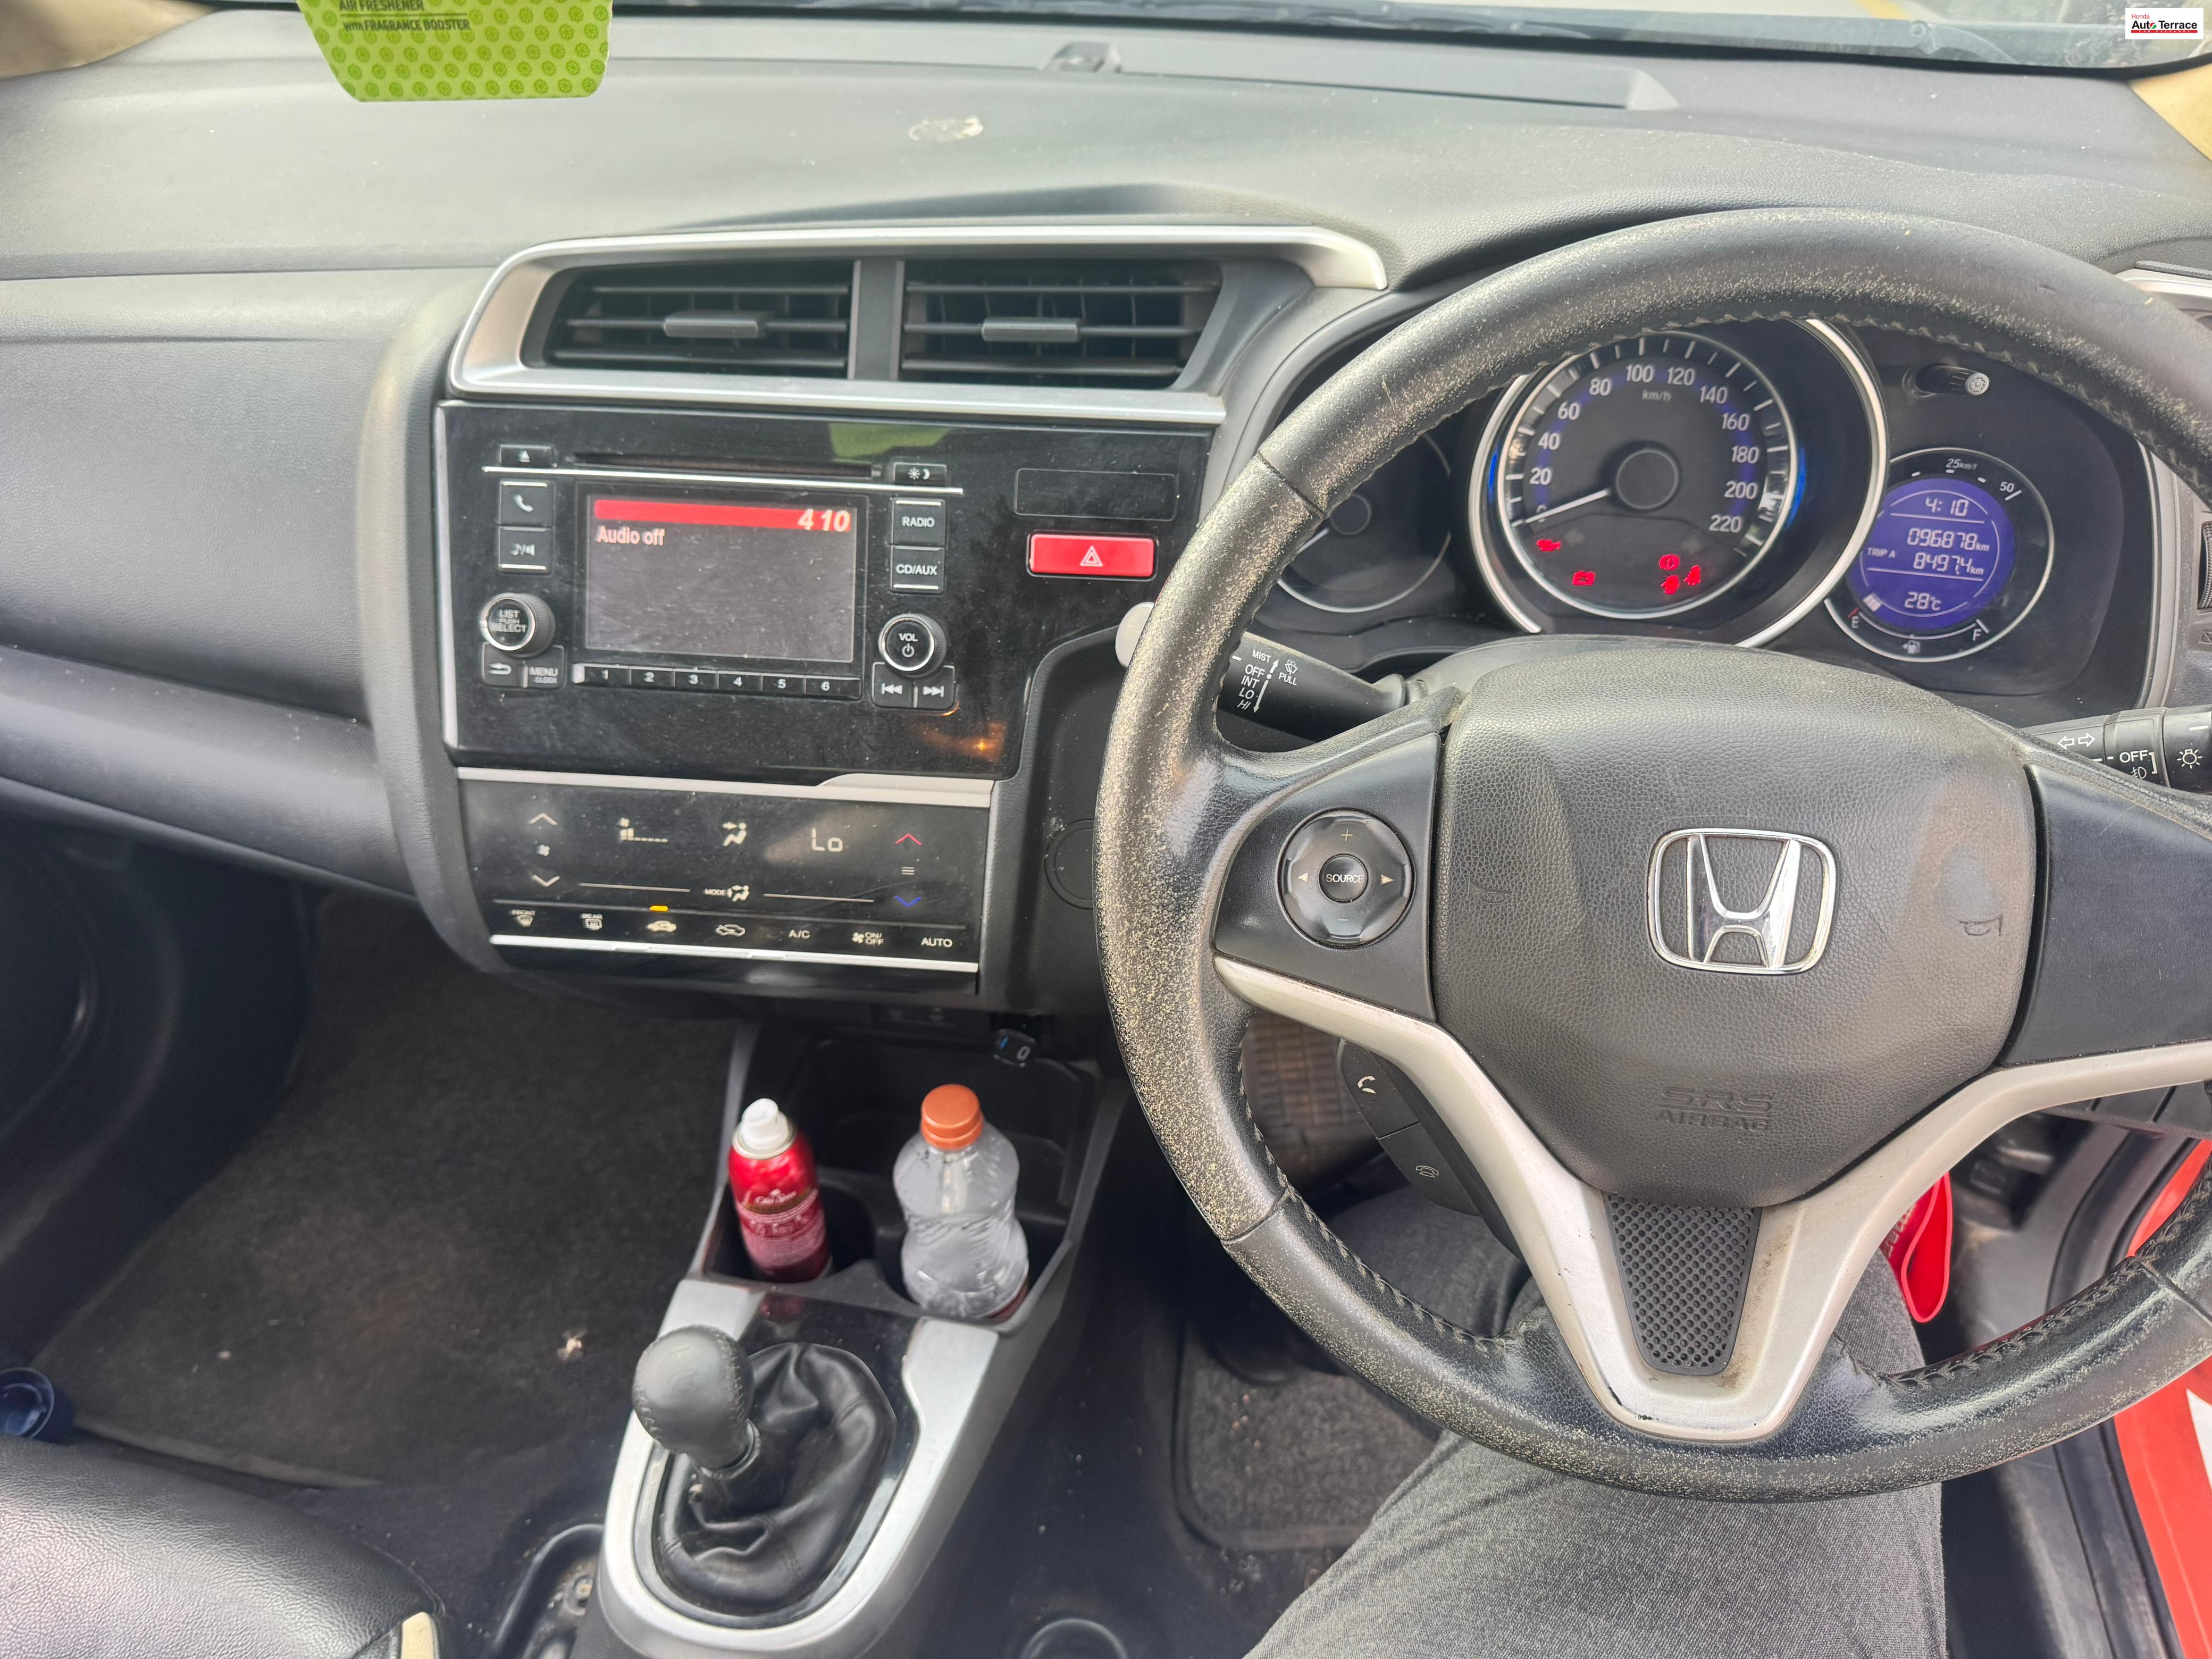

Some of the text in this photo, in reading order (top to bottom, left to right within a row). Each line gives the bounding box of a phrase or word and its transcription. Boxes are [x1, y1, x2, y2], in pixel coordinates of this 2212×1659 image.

[340, 0, 358, 11] AIR
[364, 20, 422, 31] FRAGRANCE
[424, 19, 470, 30] BOOSTER
[1625, 364, 1655, 383] 100
[1666, 365, 1695, 385] 120
[1589, 377, 1611, 397] 80
[1641, 389, 1671, 403] km/h
[1699, 385, 1729, 405] 140
[1557, 402, 1580, 422] 60
[1721, 411, 1750, 431] 160
[1538, 431, 1561, 450] 40
[1731, 444, 1759, 464] 180
[1529, 467, 1553, 486] 20
[1723, 480, 1757, 500] 200
[1999, 481, 2015, 492] 50
[901, 516, 935, 527] RADIO
[1708, 514, 1742, 533] 220
[596, 525, 665, 546] Audio off
[1866, 547, 1888, 558] TRIP
[1889, 550, 1896, 558] A
[895, 564, 937, 576] CD/AUX
[498, 609, 521, 619] LIST
[492, 623, 527, 633] SELECT
[1851, 615, 1859, 629] E
[898, 632, 919, 642] VOL
[1972, 629, 1982, 641] F
[1252, 649, 1271, 663] MIST
[529, 666, 558, 677] MENU
[601, 669, 609, 680] 1
[643, 671, 655, 683] 2
[1245, 664, 1265, 678] OFF
[688, 674, 699, 685] 3
[733, 676, 742, 687] 4
[777, 678, 787, 689] 5
[1241, 675, 1260, 689] INT
[1278, 672, 1297, 686] PULL
[820, 681, 831, 692] 6
[1238, 687, 1254, 699] LO
[1237, 700, 1251, 710] HI
[2119, 750, 2148, 763] OFF
[1326, 874, 1363, 883] SOURCE
[703, 888, 726, 896] MODE
[789, 929, 810, 939] A/C
[921, 937, 953, 948] AUTO
[1657, 1087, 1772, 1112] SRS
[1654, 1110, 1769, 1132] AIRBAG
